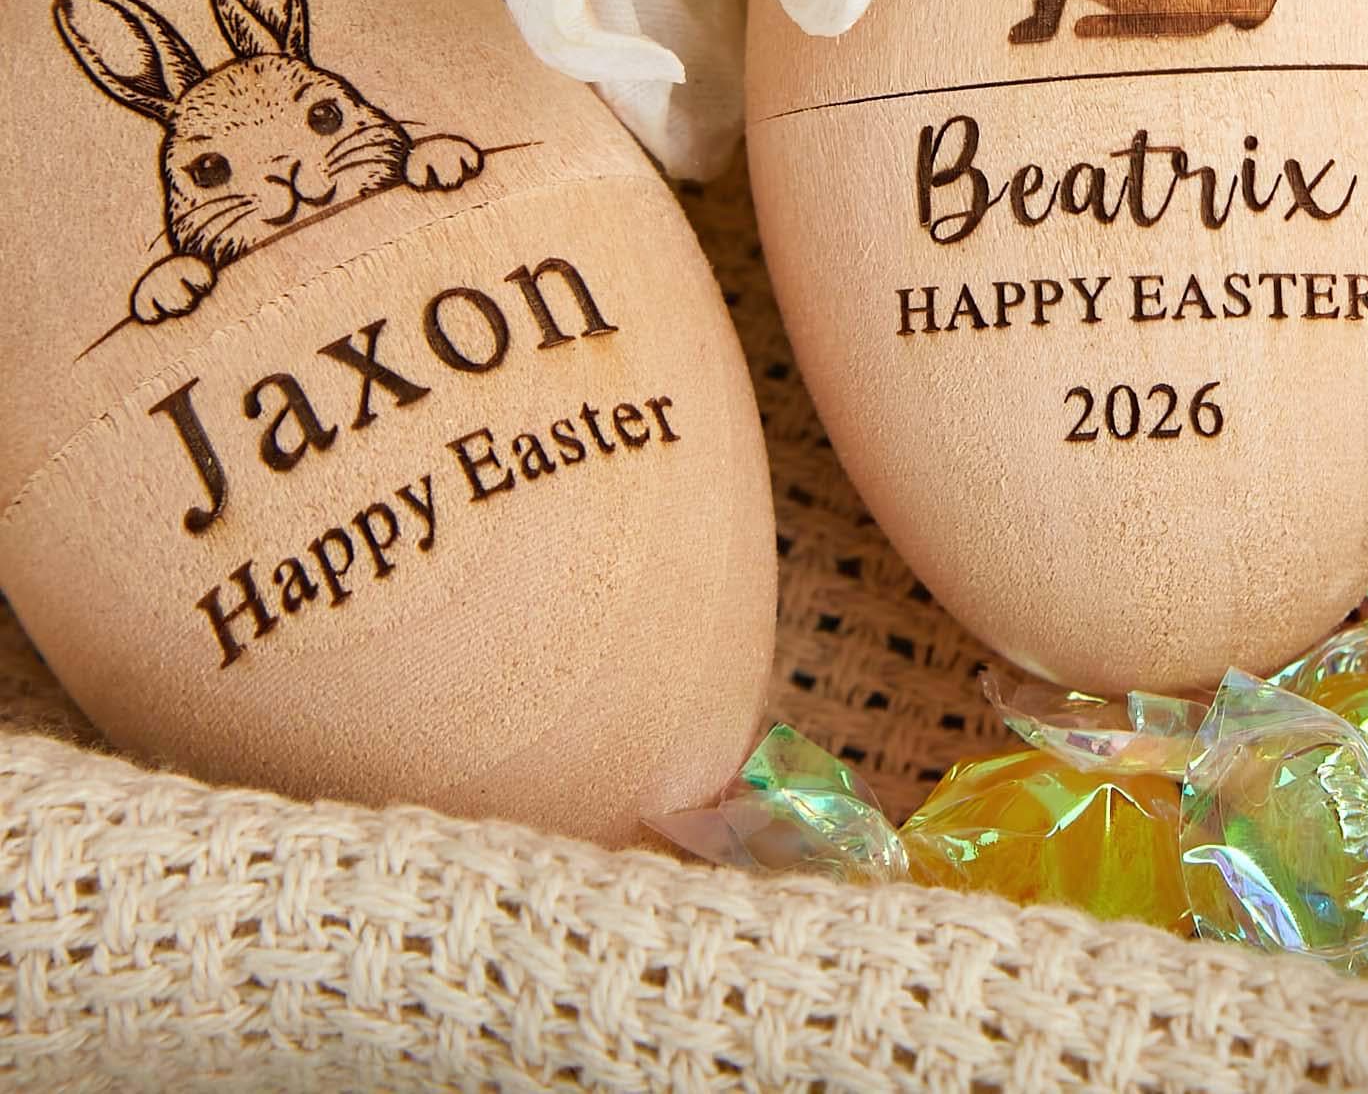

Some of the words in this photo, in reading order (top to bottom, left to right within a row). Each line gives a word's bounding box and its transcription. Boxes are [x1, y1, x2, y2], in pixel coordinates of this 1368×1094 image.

[916, 114, 1358, 246] Beatrix
[895, 275, 1112, 338] HAPPY
[148, 252, 619, 539] Jaxon
[1063, 381, 1224, 444] 2026
[195, 474, 437, 671] Happy
[445, 396, 681, 503] Easter
